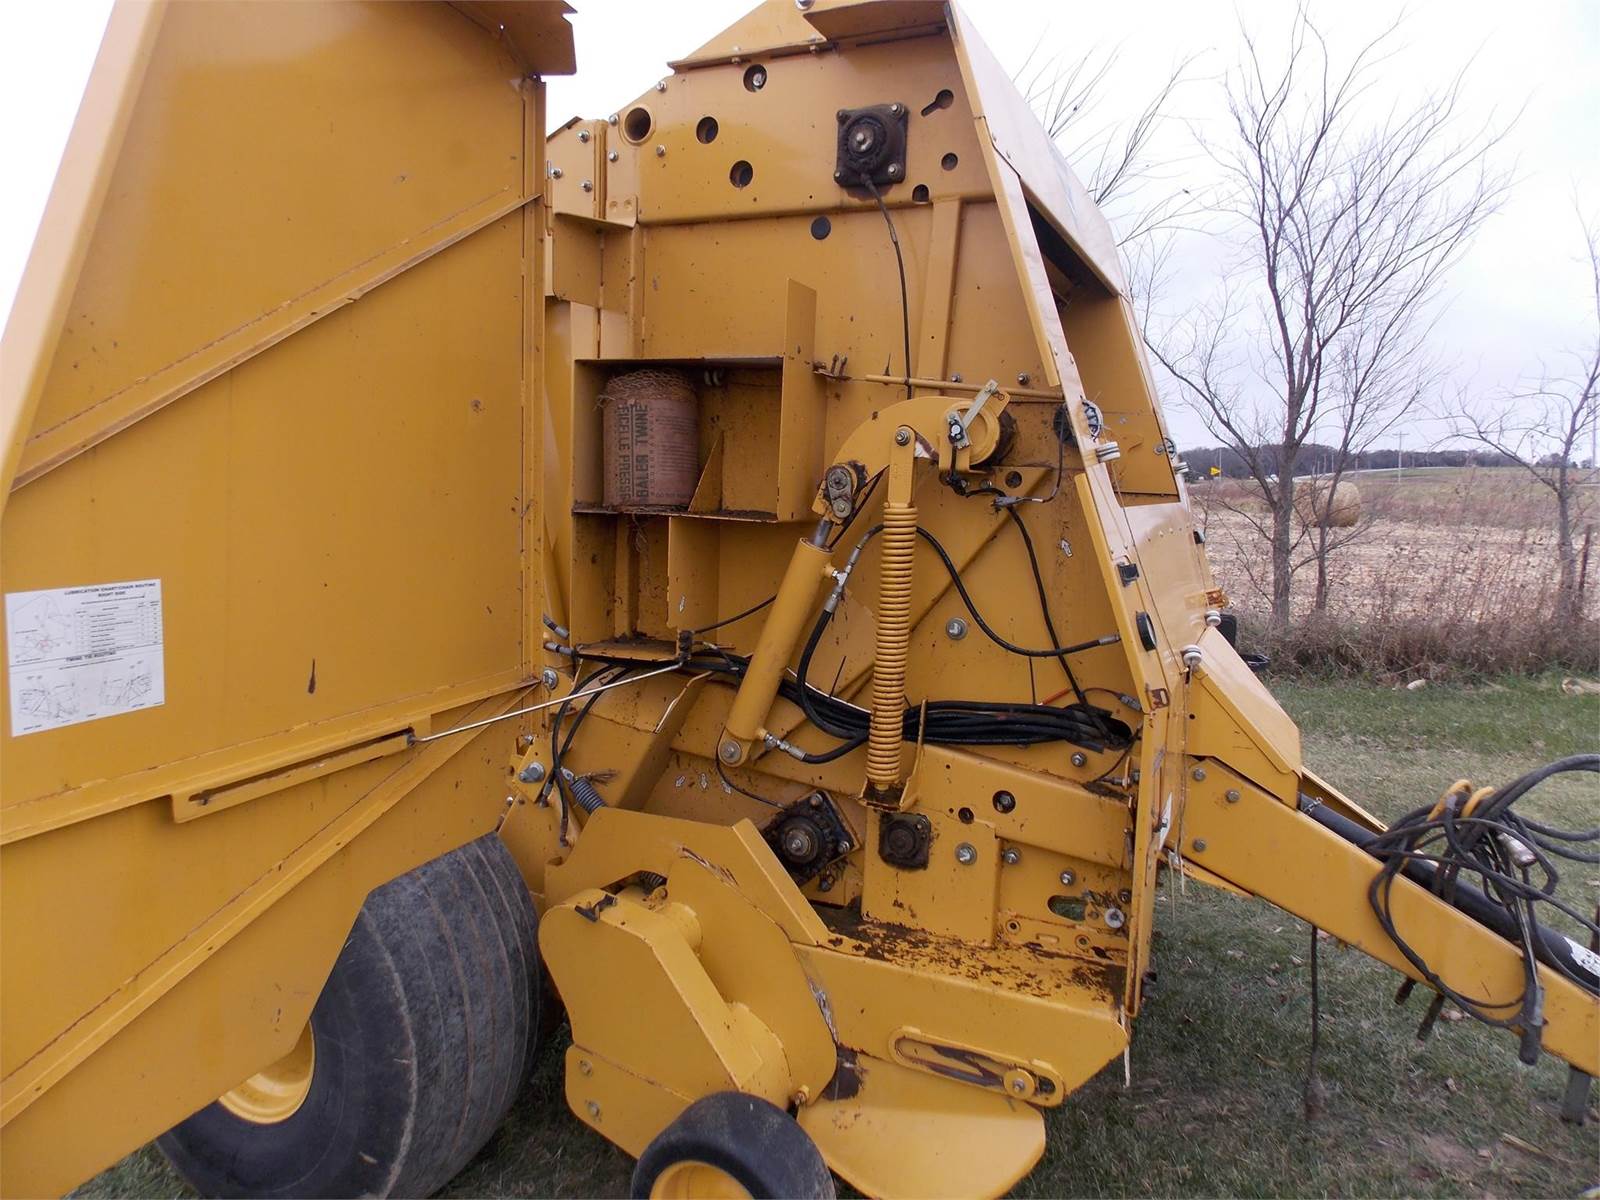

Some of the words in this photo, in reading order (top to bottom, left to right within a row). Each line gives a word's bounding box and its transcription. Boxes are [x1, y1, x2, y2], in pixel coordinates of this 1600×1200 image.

[618, 404, 631, 451] FICELLE
[635, 404, 649, 446] TWINE
[635, 454, 649, 498] BALER
